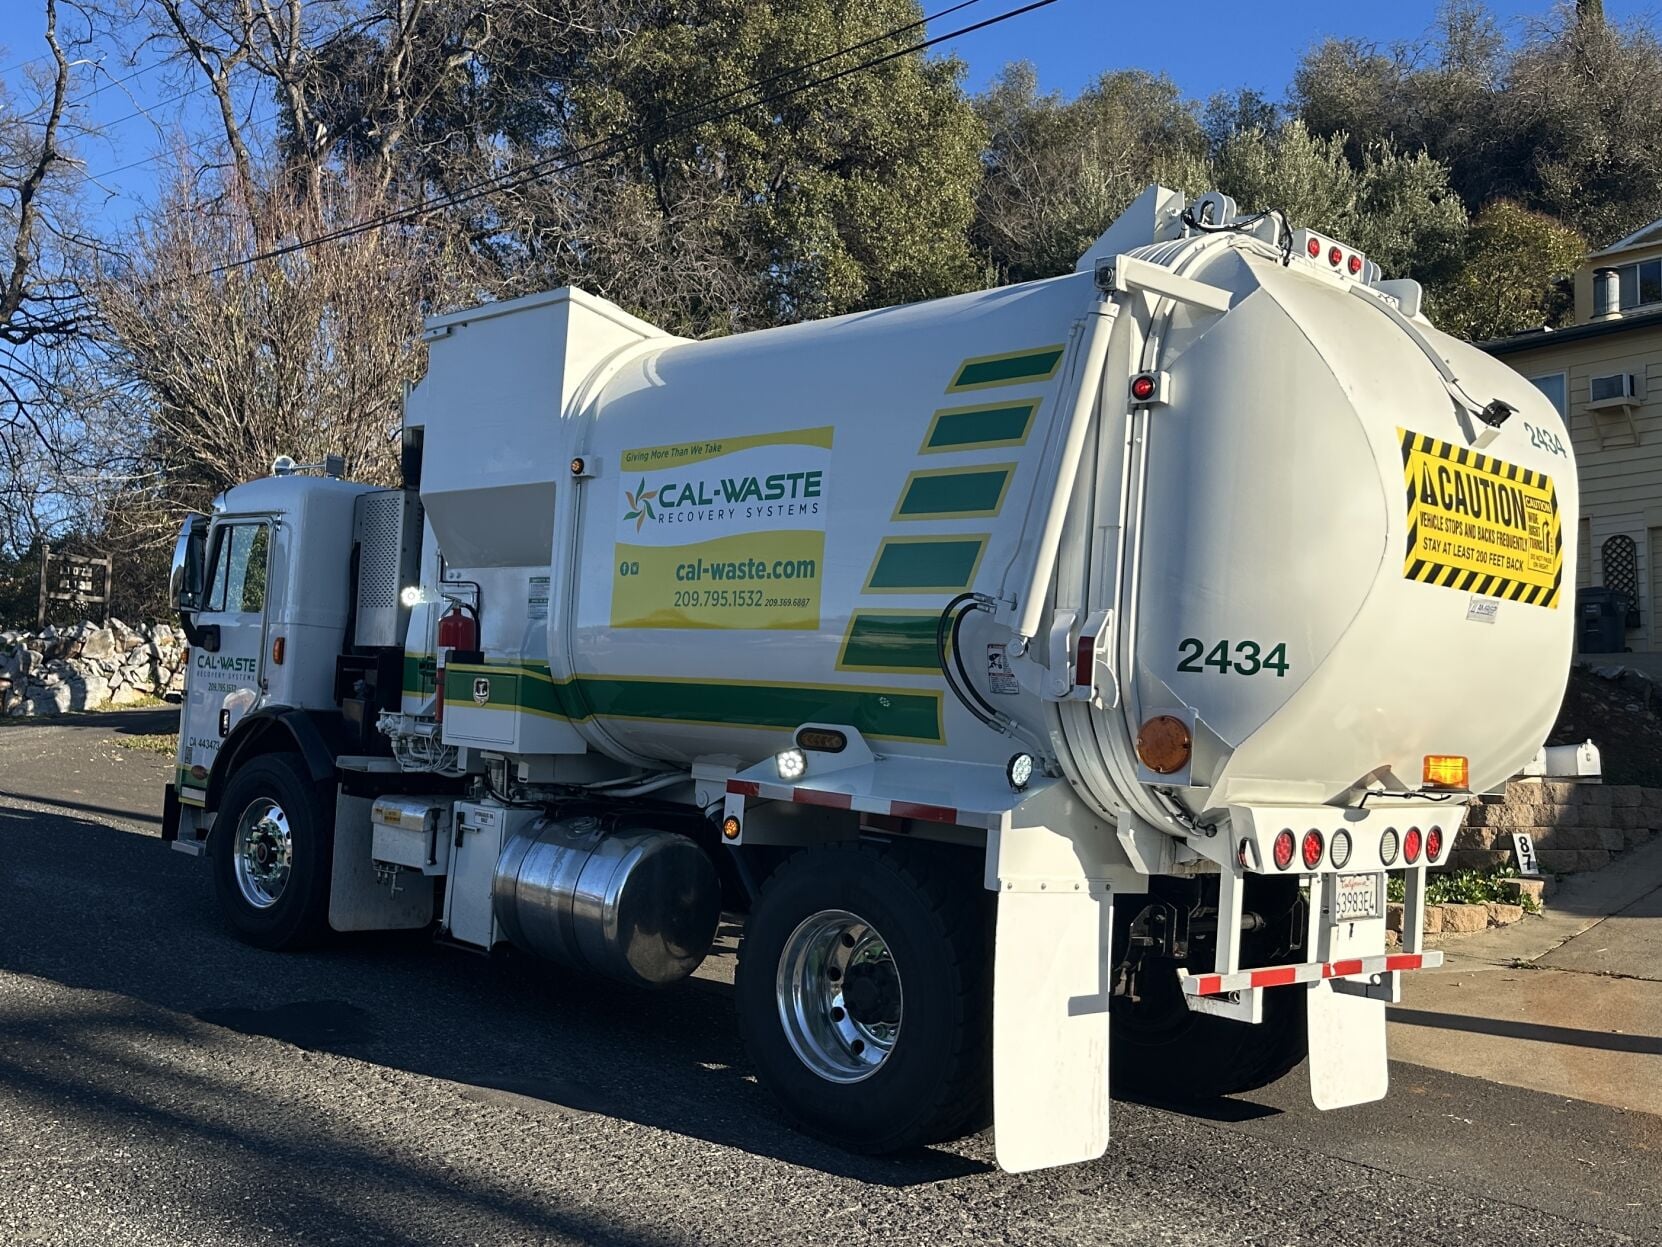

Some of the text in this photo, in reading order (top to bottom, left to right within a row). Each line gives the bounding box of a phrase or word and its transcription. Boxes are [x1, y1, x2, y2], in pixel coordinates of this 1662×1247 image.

[1524, 421, 1567, 459] 2434
[626, 443, 722, 462] Giving More Than We Take
[658, 470, 823, 508] CAL-WASTE
[1438, 465, 1527, 531] CAUTION
[658, 502, 819, 524] RECOVERY SYSTEMS
[1525, 496, 1552, 514] CAUTION
[1419, 511, 1444, 531] VEHICLE
[1445, 517, 1463, 536] STOPS
[1464, 522, 1477, 540] AND
[1477, 526, 1495, 544] BACKS
[1496, 530, 1528, 552] FREQUENTLY
[1423, 537, 1524, 572] STAY AT LEAST 200 FEET BACK
[676, 558, 815, 581] cal-waste.com
[674, 590, 763, 607] 209.795.1532
[764, 598, 810, 607] 209.369.6887
[1177, 638, 1290, 677] 2434
[196, 670, 255, 681] RECOVERY SYSTEMS
